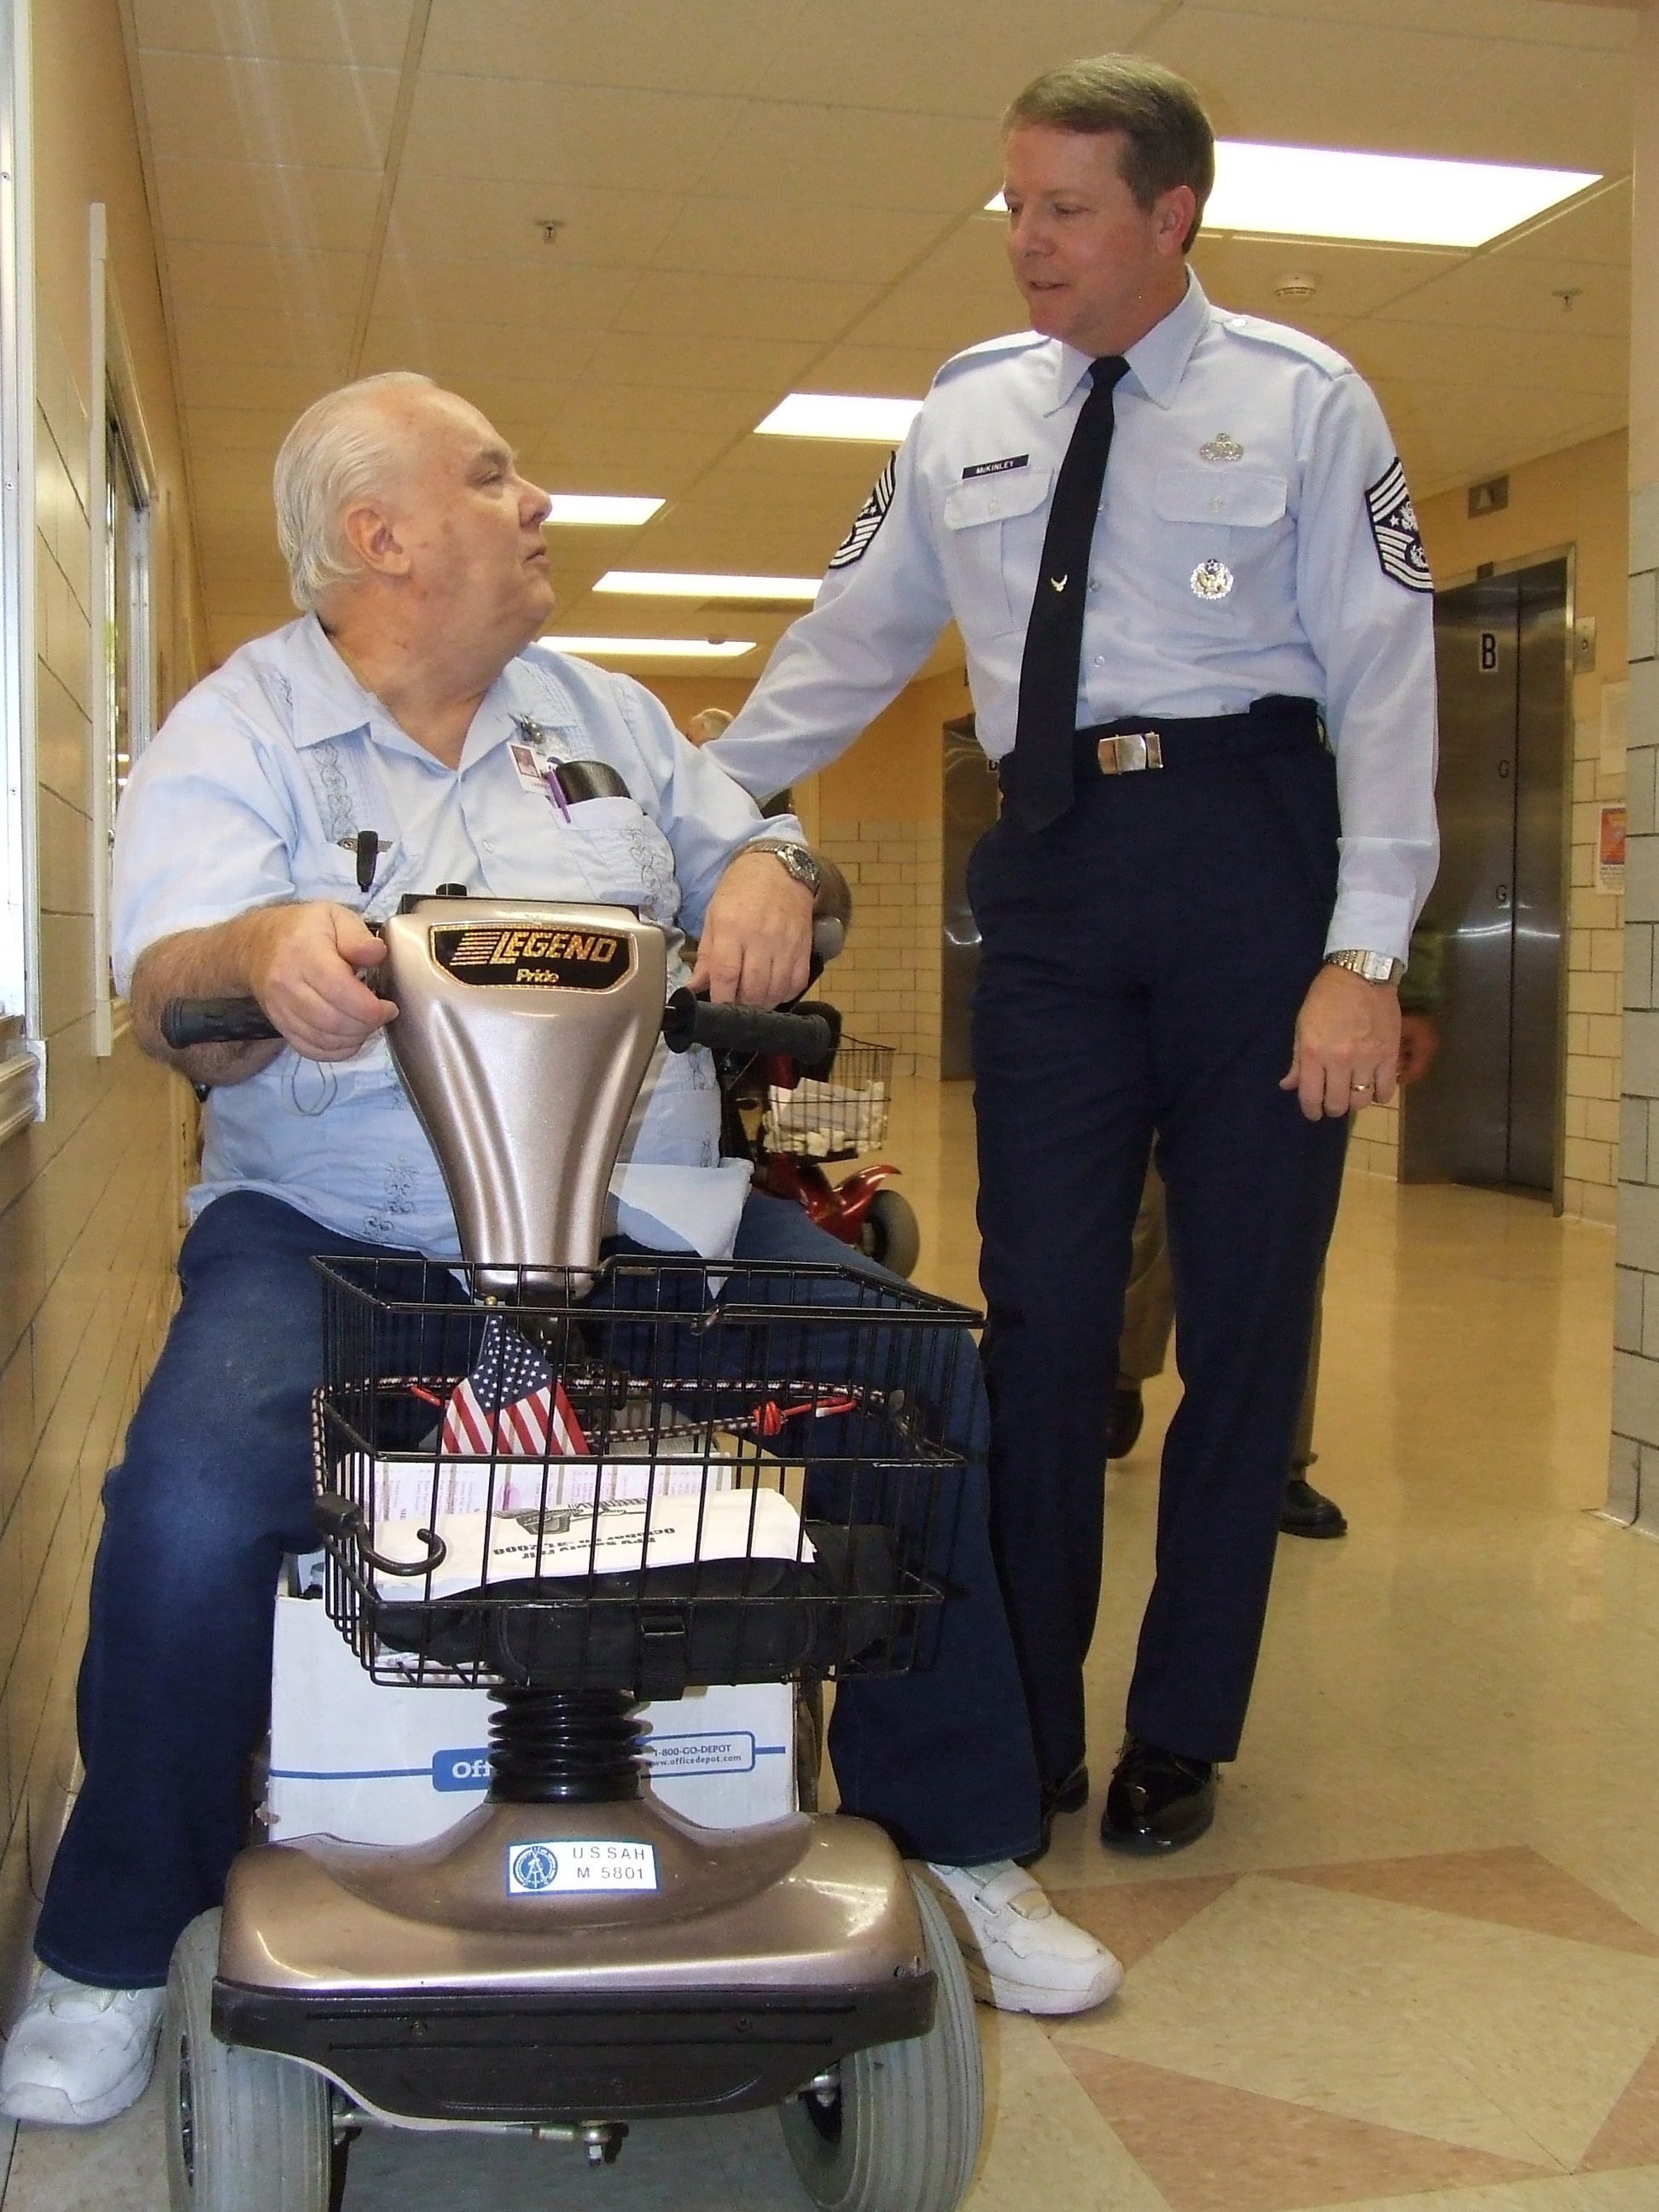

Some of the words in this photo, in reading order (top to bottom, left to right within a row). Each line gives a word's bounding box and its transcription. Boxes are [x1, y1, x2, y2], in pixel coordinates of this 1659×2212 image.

[1482, 633, 1495, 668] B
[488, 931, 617, 964] LEGEND
[516, 969, 559, 982] Pride
[654, 1744, 731, 1756] 1-800-GO-DEPOT
[577, 1867, 591, 1878] M
[602, 1866, 643, 1879] 5801
